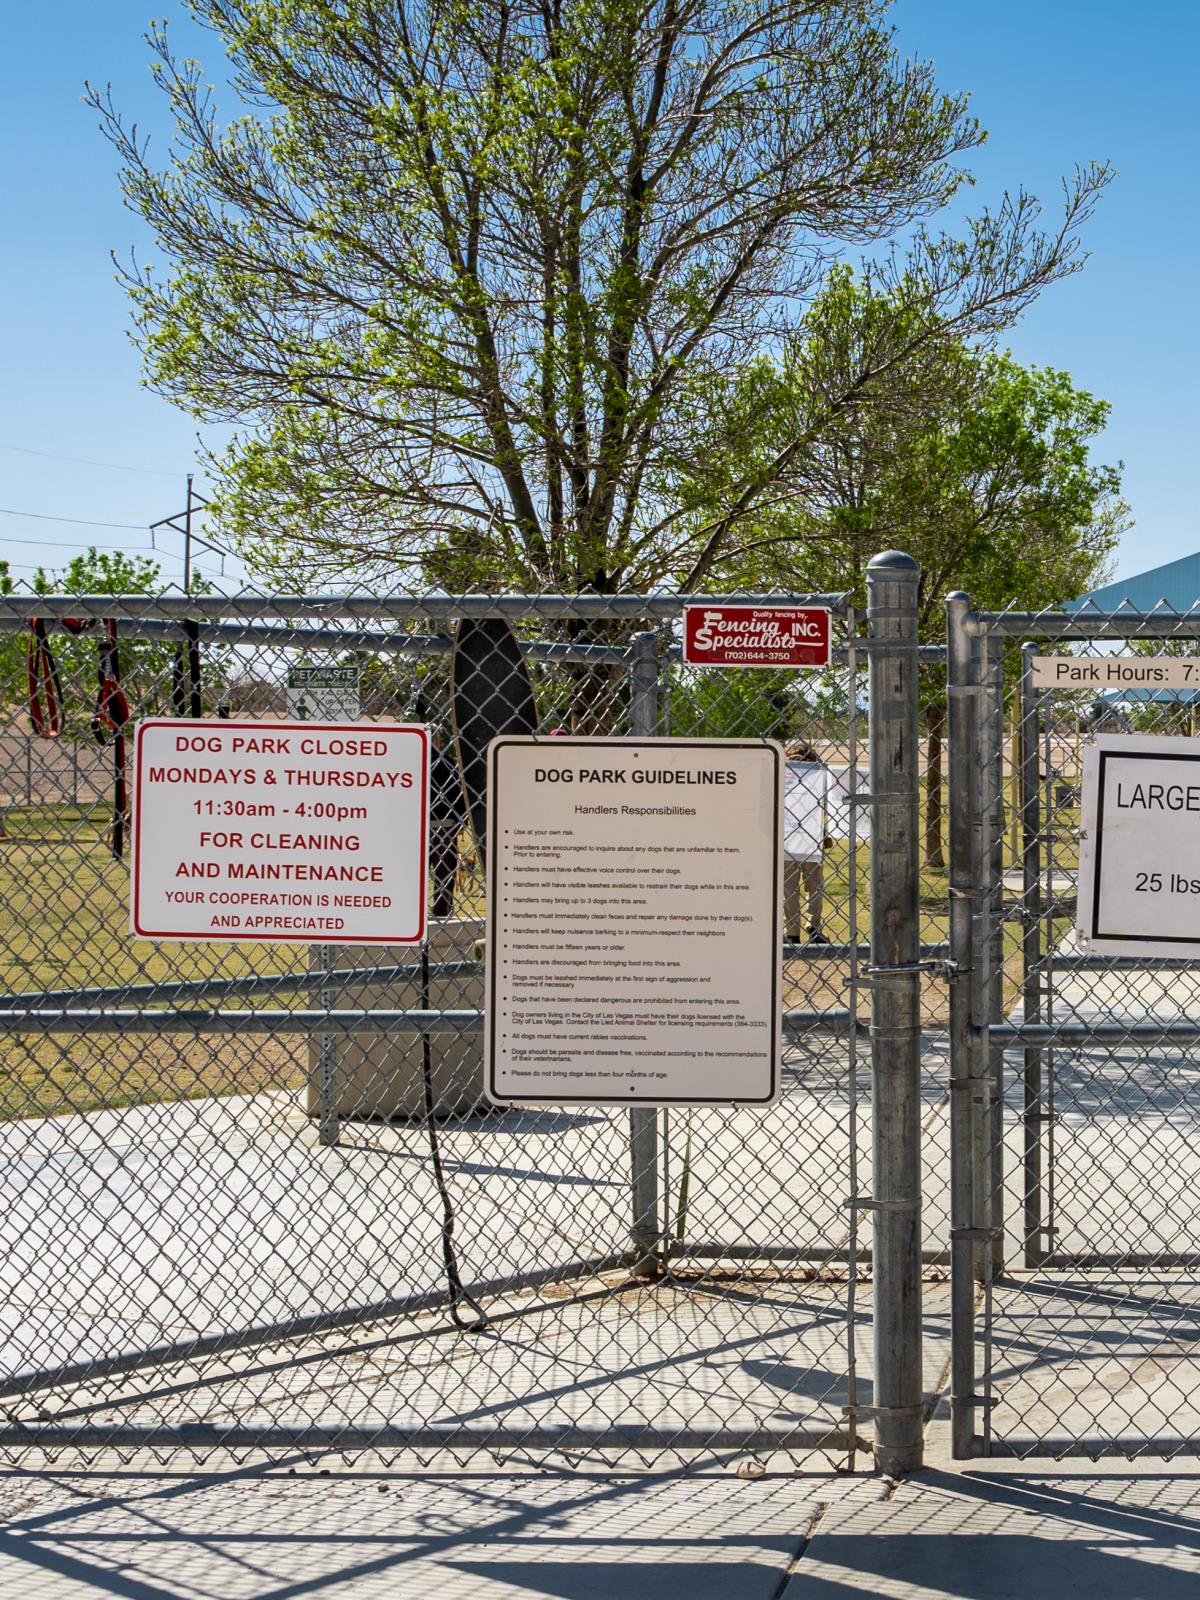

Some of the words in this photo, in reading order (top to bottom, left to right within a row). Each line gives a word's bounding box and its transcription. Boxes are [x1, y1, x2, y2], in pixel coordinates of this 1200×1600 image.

[752, 610, 772, 618] Quality
[704, 611, 782, 638] Fencing
[791, 622, 822, 637] INC.
[693, 628, 796, 651] Specialists
[1056, 663, 1100, 680] Park
[1107, 663, 1168, 681] Hours:
[176, 736, 221, 752] DOG
[232, 737, 290, 754] PARK
[300, 739, 387, 756] CLOSED
[149, 767, 256, 784] MONDAYS
[263, 769, 277, 784] &
[284, 769, 412, 788] THURSDAYS
[534, 768, 573, 783] DOG
[578, 769, 626, 783] PARK
[631, 769, 737, 784] GUIDELINES
[1117, 782, 1200, 811] LARGE
[193, 799, 275, 816] 11:30am
[294, 802, 366, 822] 4:00pm
[574, 805, 618, 814] Handlers
[621, 805, 696, 816] Responsibilities
[200, 832, 243, 848] FOR
[250, 833, 359, 850] CLEANING
[175, 862, 220, 877] AND
[228, 863, 383, 882] MAINTENANCE
[1134, 872, 1162, 892] 25
[1170, 874, 1200, 894] lbs
[164, 891, 204, 903] YOUR
[209, 892, 312, 906] COOPERATION
[317, 894, 329, 906] IS
[334, 895, 391, 907] NEEDED
[210, 915, 240, 928] AND
[245, 916, 344, 930] APPRECIATED
